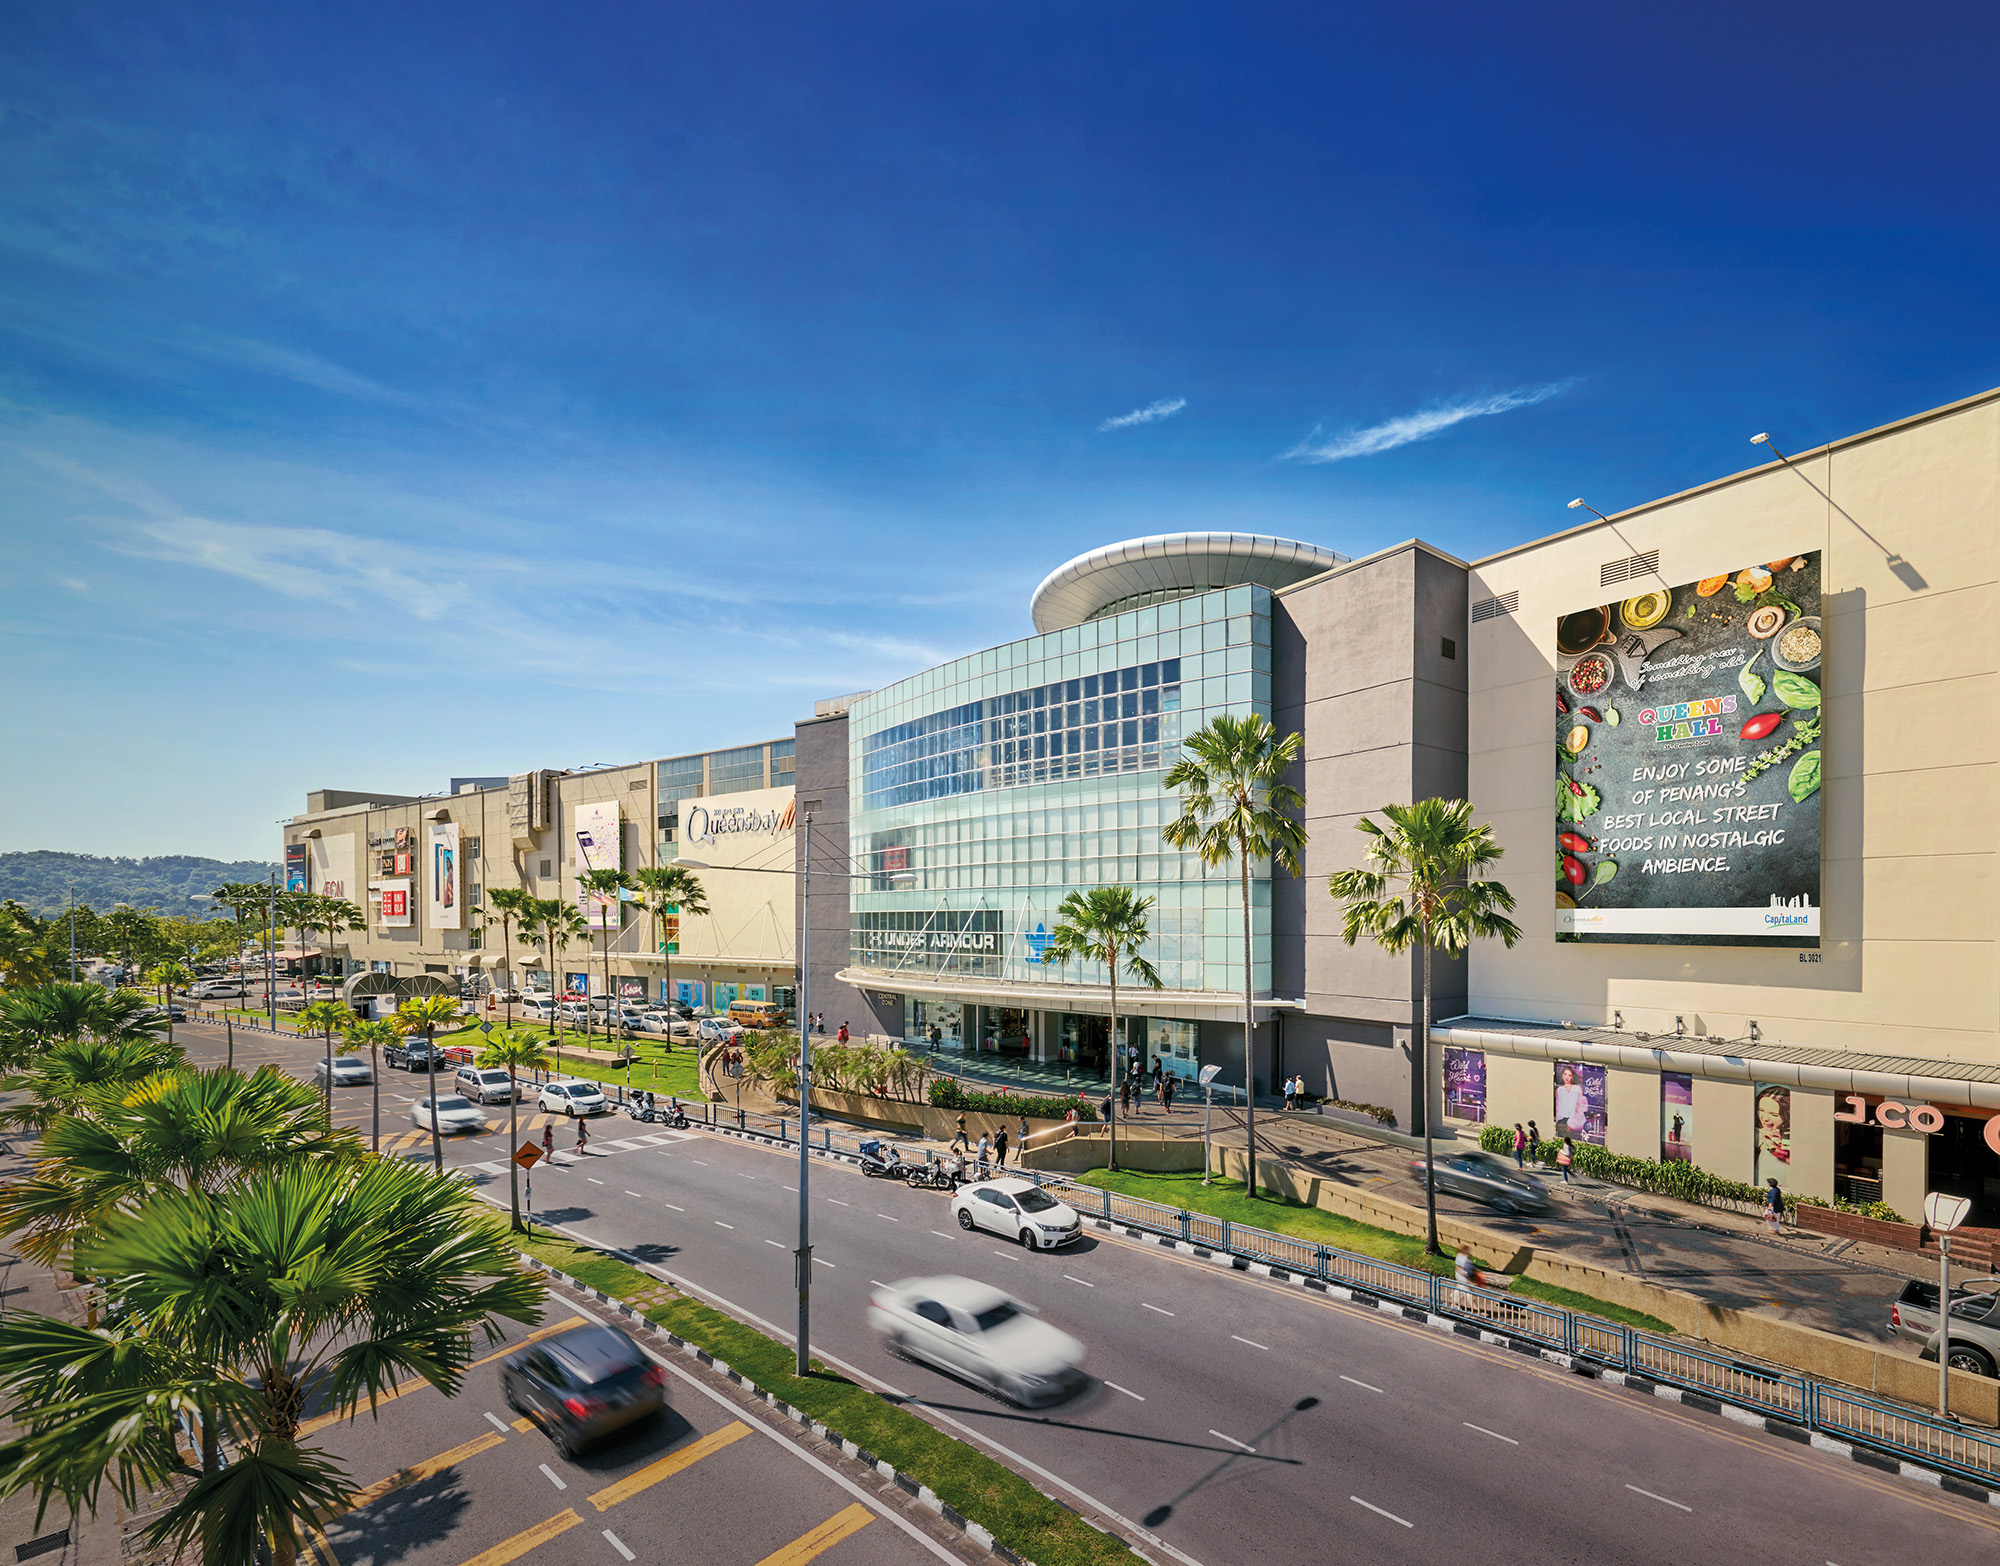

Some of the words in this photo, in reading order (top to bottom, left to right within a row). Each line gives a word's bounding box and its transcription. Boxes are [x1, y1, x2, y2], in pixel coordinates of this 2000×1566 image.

[1630, 674, 1646, 691] of
[1648, 664, 1716, 682] something
[1719, 654, 1747, 669] old
[1639, 654, 1706, 674] Something
[1709, 647, 1738, 660] new
[1639, 694, 1738, 726] QUEENS
[1656, 718, 1722, 742] HALL
[1632, 762, 1690, 782] ENJOY
[1695, 756, 1747, 776] SOME
[1632, 789, 1654, 806] OF
[1660, 781, 1747, 804] PENANG'S
[686, 805, 781, 845] Queensbay
[1603, 813, 1646, 831] BEST
[1650, 809, 1708, 828] LOCAL
[1712, 803, 1784, 824] STREET
[1600, 836, 1653, 853] FOODS
[1659, 835, 1677, 850] IN
[1682, 829, 1786, 849] NOSTALGIC
[1641, 856, 1731, 875] AMBIENCE.
[1764, 912, 1808, 926] CapitaLand
[884, 932, 927, 947] UNDER
[930, 933, 995, 949] ARMOUR
[1799, 953, 1808, 963] BL
[1834, 1096, 1945, 1133] J.CO
